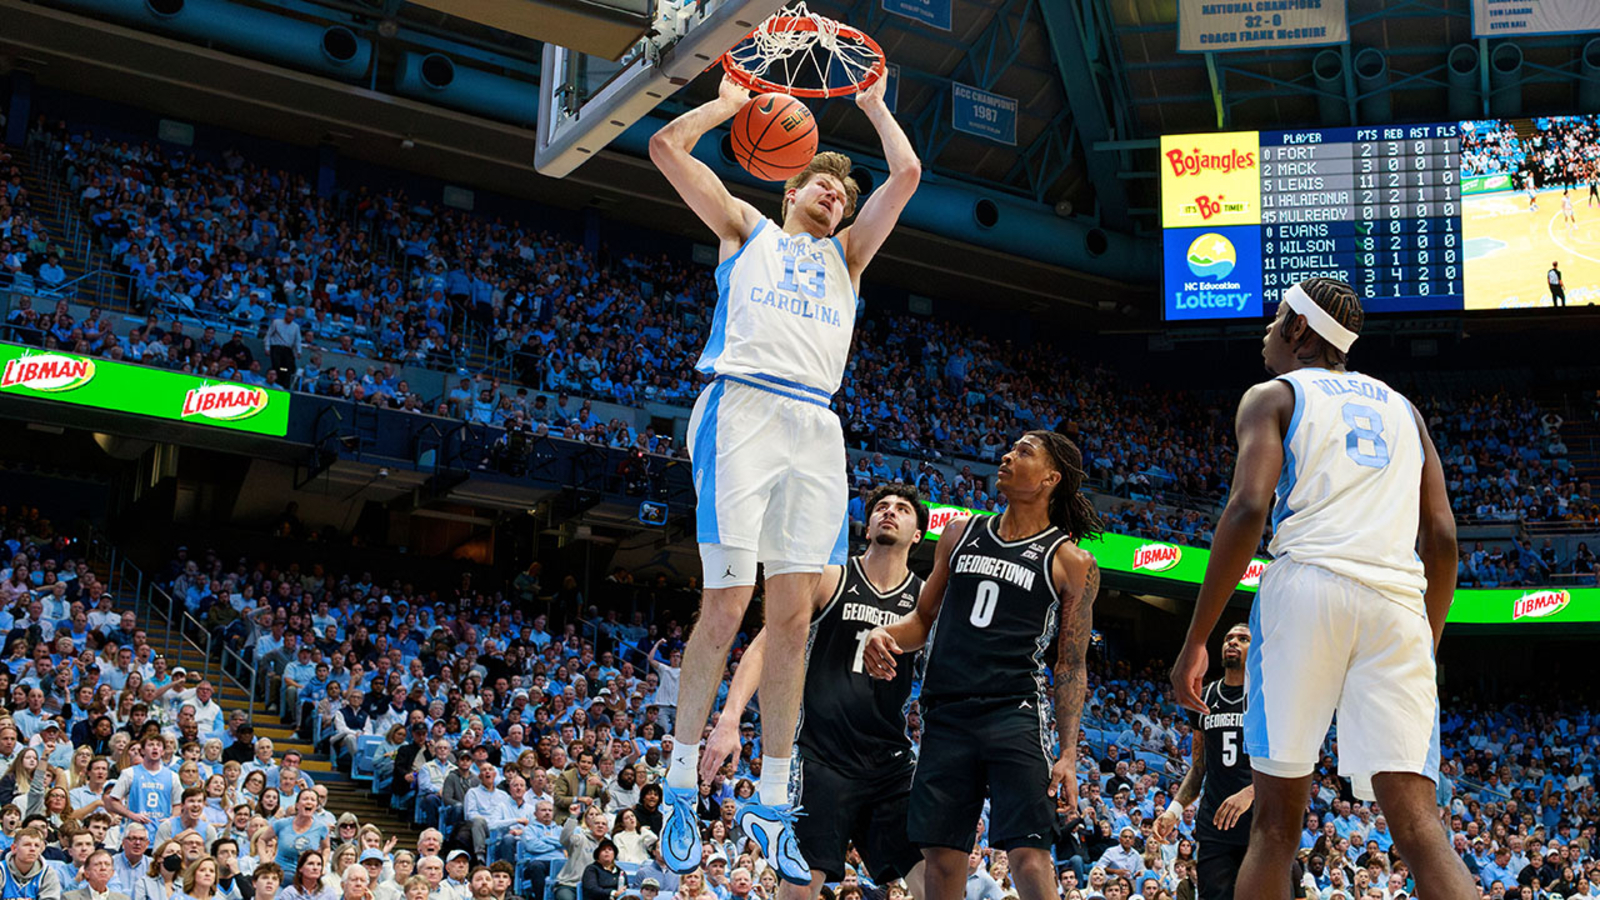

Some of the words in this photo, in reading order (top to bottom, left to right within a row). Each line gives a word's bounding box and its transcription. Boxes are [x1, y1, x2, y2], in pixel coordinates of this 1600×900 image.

[1202, 3, 1254, 14] NATIONAL
[1255, 0, 1321, 11] CHAMPIONS
[1245, 15, 1262, 28] 32
[1272, 14, 1282, 26] 0
[1200, 32, 1237, 44] COACH
[1240, 30, 1275, 41] FRANK
[972, 92, 1015, 112] CHAMPIONS
[781, 106, 811, 132] ELITE
[973, 105, 998, 123] 1987
[1283, 132, 1322, 144] PLAYER
[1357, 129, 1378, 140] PTS
[1384, 128, 1403, 139] REB
[1410, 127, 1430, 138] AST
[1436, 126, 1456, 137] FLS
[1264, 149, 1271, 160] 0
[1277, 146, 1316, 160] FORT
[1361, 143, 1371, 157] 2
[1388, 142, 1398, 156] 3
[1415, 141, 1425, 154] 0
[1443, 139, 1450, 153] 1
[1165, 147, 1255, 177] Bojangles
[1264, 164, 1271, 176] 2
[1277, 162, 1317, 176] MACK
[1361, 159, 1372, 173] 3
[1388, 158, 1399, 171] 0
[1415, 156, 1425, 170] 0
[1444, 155, 1451, 169] 1
[1264, 180, 1272, 192] 5
[1278, 177, 1324, 191] LEWIS
[1360, 175, 1374, 188] 11
[1389, 174, 1399, 187] 2
[1417, 172, 1424, 186] 1
[1442, 171, 1453, 185] 0
[1195, 195, 1221, 220] Bo
[1263, 195, 1274, 207] 11
[1279, 192, 1349, 207] HALAIFONUA
[1362, 190, 1373, 204] 2
[1389, 189, 1400, 203] 2
[1418, 188, 1425, 201] 1
[1444, 187, 1452, 200] 1
[1262, 211, 1277, 223] 45
[1279, 208, 1348, 222] MULREADY
[1363, 206, 1373, 219] 0
[1389, 205, 1400, 219] 0
[1416, 204, 1427, 217] 0
[1444, 202, 1454, 216] 0
[1266, 226, 1273, 238] 0
[1280, 224, 1328, 238] EVANS
[1363, 222, 1374, 235] 7
[1390, 220, 1401, 234] 0
[1417, 219, 1428, 233] 2
[1445, 218, 1453, 232] 1
[1265, 242, 1274, 254] 8
[1280, 239, 1336, 254] WILSON
[1363, 237, 1374, 251] 8
[1390, 236, 1401, 250] 2
[1417, 234, 1428, 248] 0
[1444, 233, 1455, 247] 0
[1264, 258, 1276, 270] 11
[1280, 255, 1339, 269] POWELL
[1364, 253, 1375, 267] 0
[1392, 252, 1400, 265] 1
[1418, 251, 1428, 264] 0
[1445, 249, 1455, 263] 0
[777, 255, 825, 300] 13
[1184, 282, 1198, 291] NC
[1199, 281, 1240, 291] Education
[1264, 273, 1277, 286] 13
[1364, 269, 1375, 283] 3
[1391, 267, 1402, 281] 4
[1418, 266, 1429, 280] 2
[1445, 265, 1456, 279] 0
[1175, 291, 1250, 312] Lottery
[1263, 288, 1279, 301] 44
[1365, 284, 1376, 298] 6
[1393, 283, 1401, 297] 1
[1419, 282, 1430, 296] 0
[1447, 281, 1455, 295] 1
[750, 286, 841, 327] CAROLINA
[2, 360, 88, 386] LIBMAN
[1312, 379, 1389, 404] WILSON
[183, 390, 261, 415] LIBMAN
[1341, 401, 1390, 470] 8
[1133, 547, 1177, 569] LIBMAN
[955, 554, 1036, 592] GEORGETOWN
[969, 580, 1000, 628] 0
[1514, 592, 1565, 619] LIBMAN
[852, 628, 871, 674] 1
[1222, 731, 1238, 767] 5
[146, 792, 159, 808] 8
